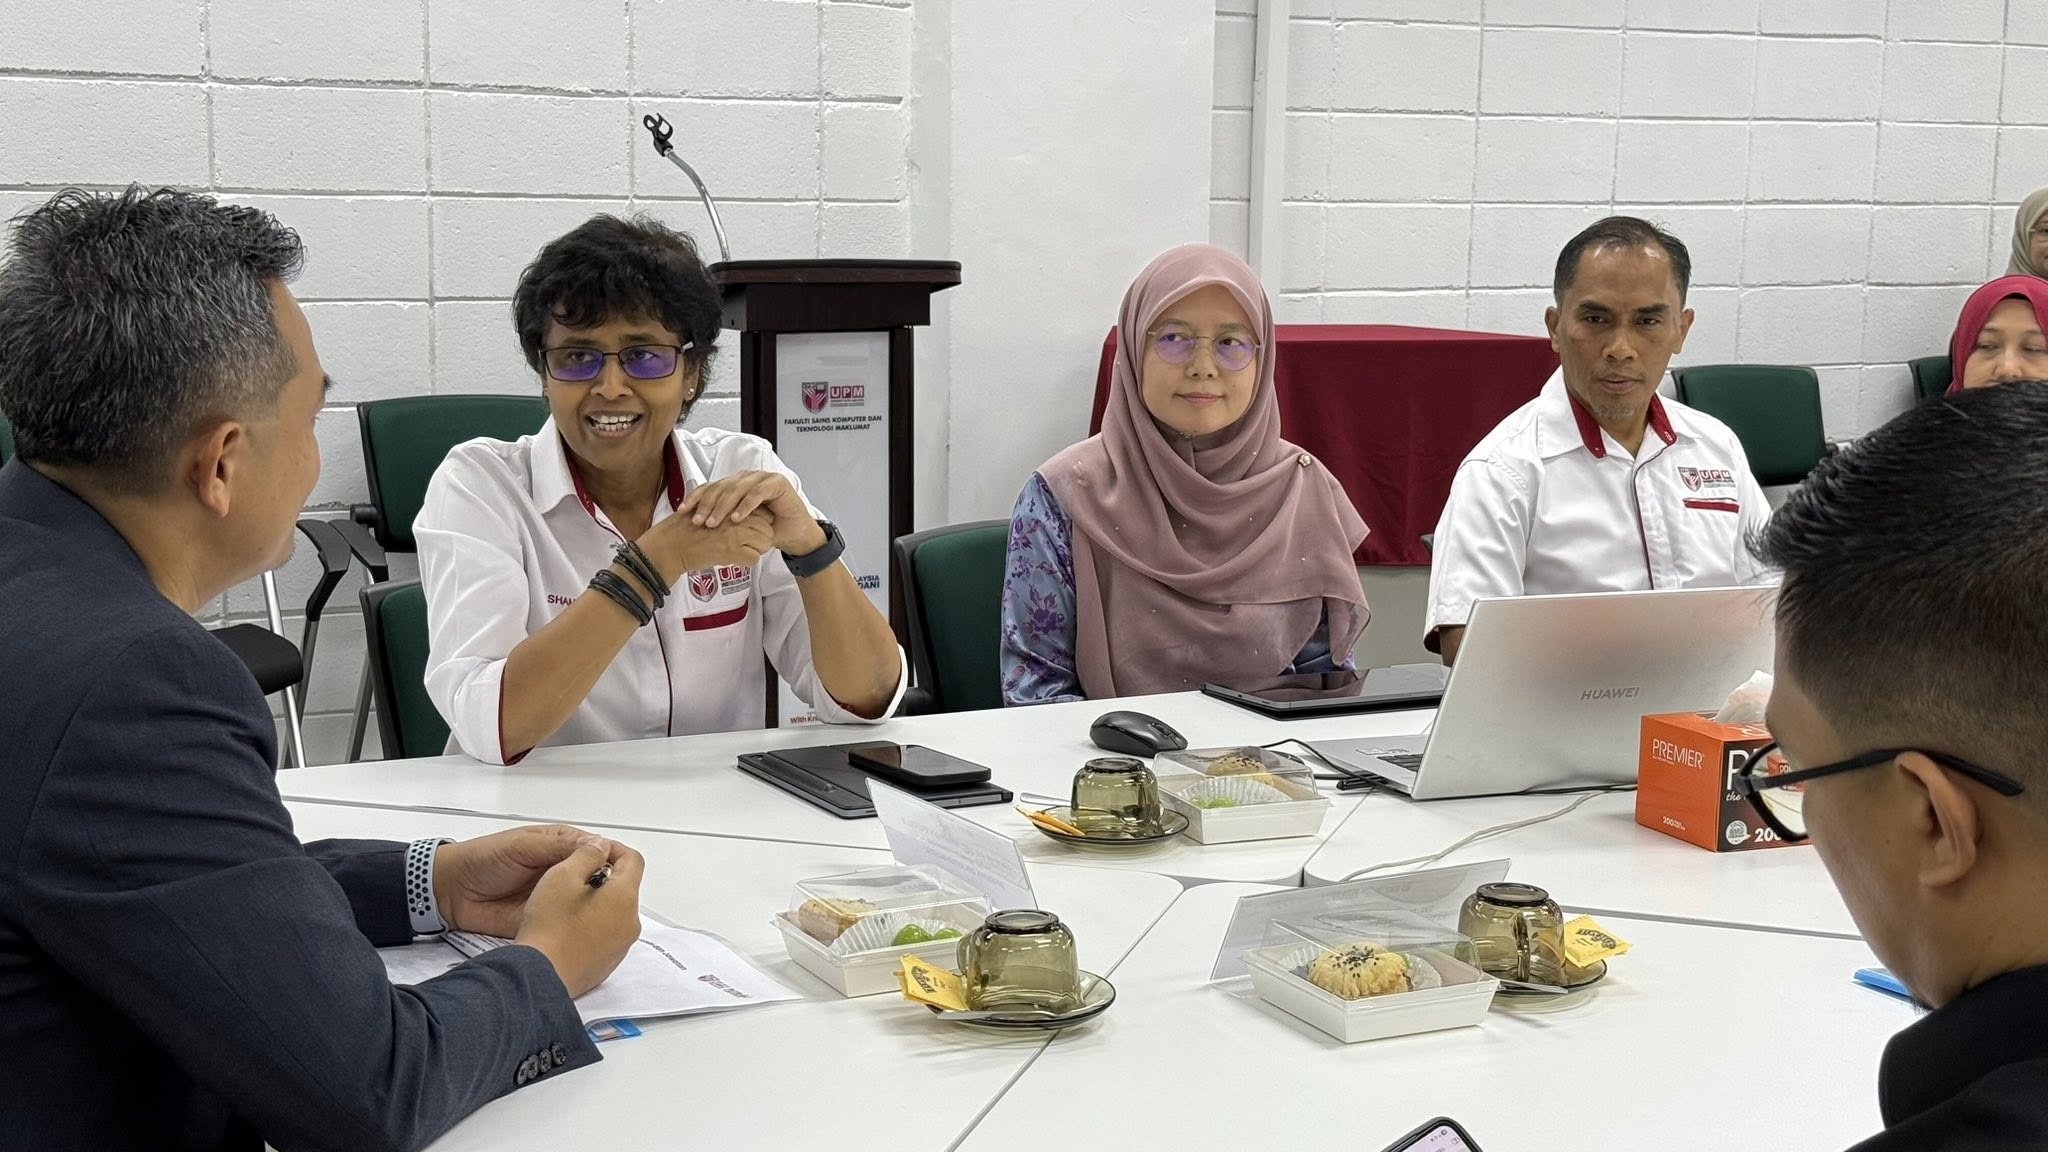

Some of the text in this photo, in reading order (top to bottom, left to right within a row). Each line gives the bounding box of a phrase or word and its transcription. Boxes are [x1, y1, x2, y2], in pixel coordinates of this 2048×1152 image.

[830, 386, 864, 399] UPM
[796, 425, 834, 433] TEKNOLOGI
[1700, 469, 1732, 480] UPM
[857, 581, 880, 589] DANI
[1580, 687, 1640, 701] HUAWEI
[1652, 738, 1703, 770] PREMIER
